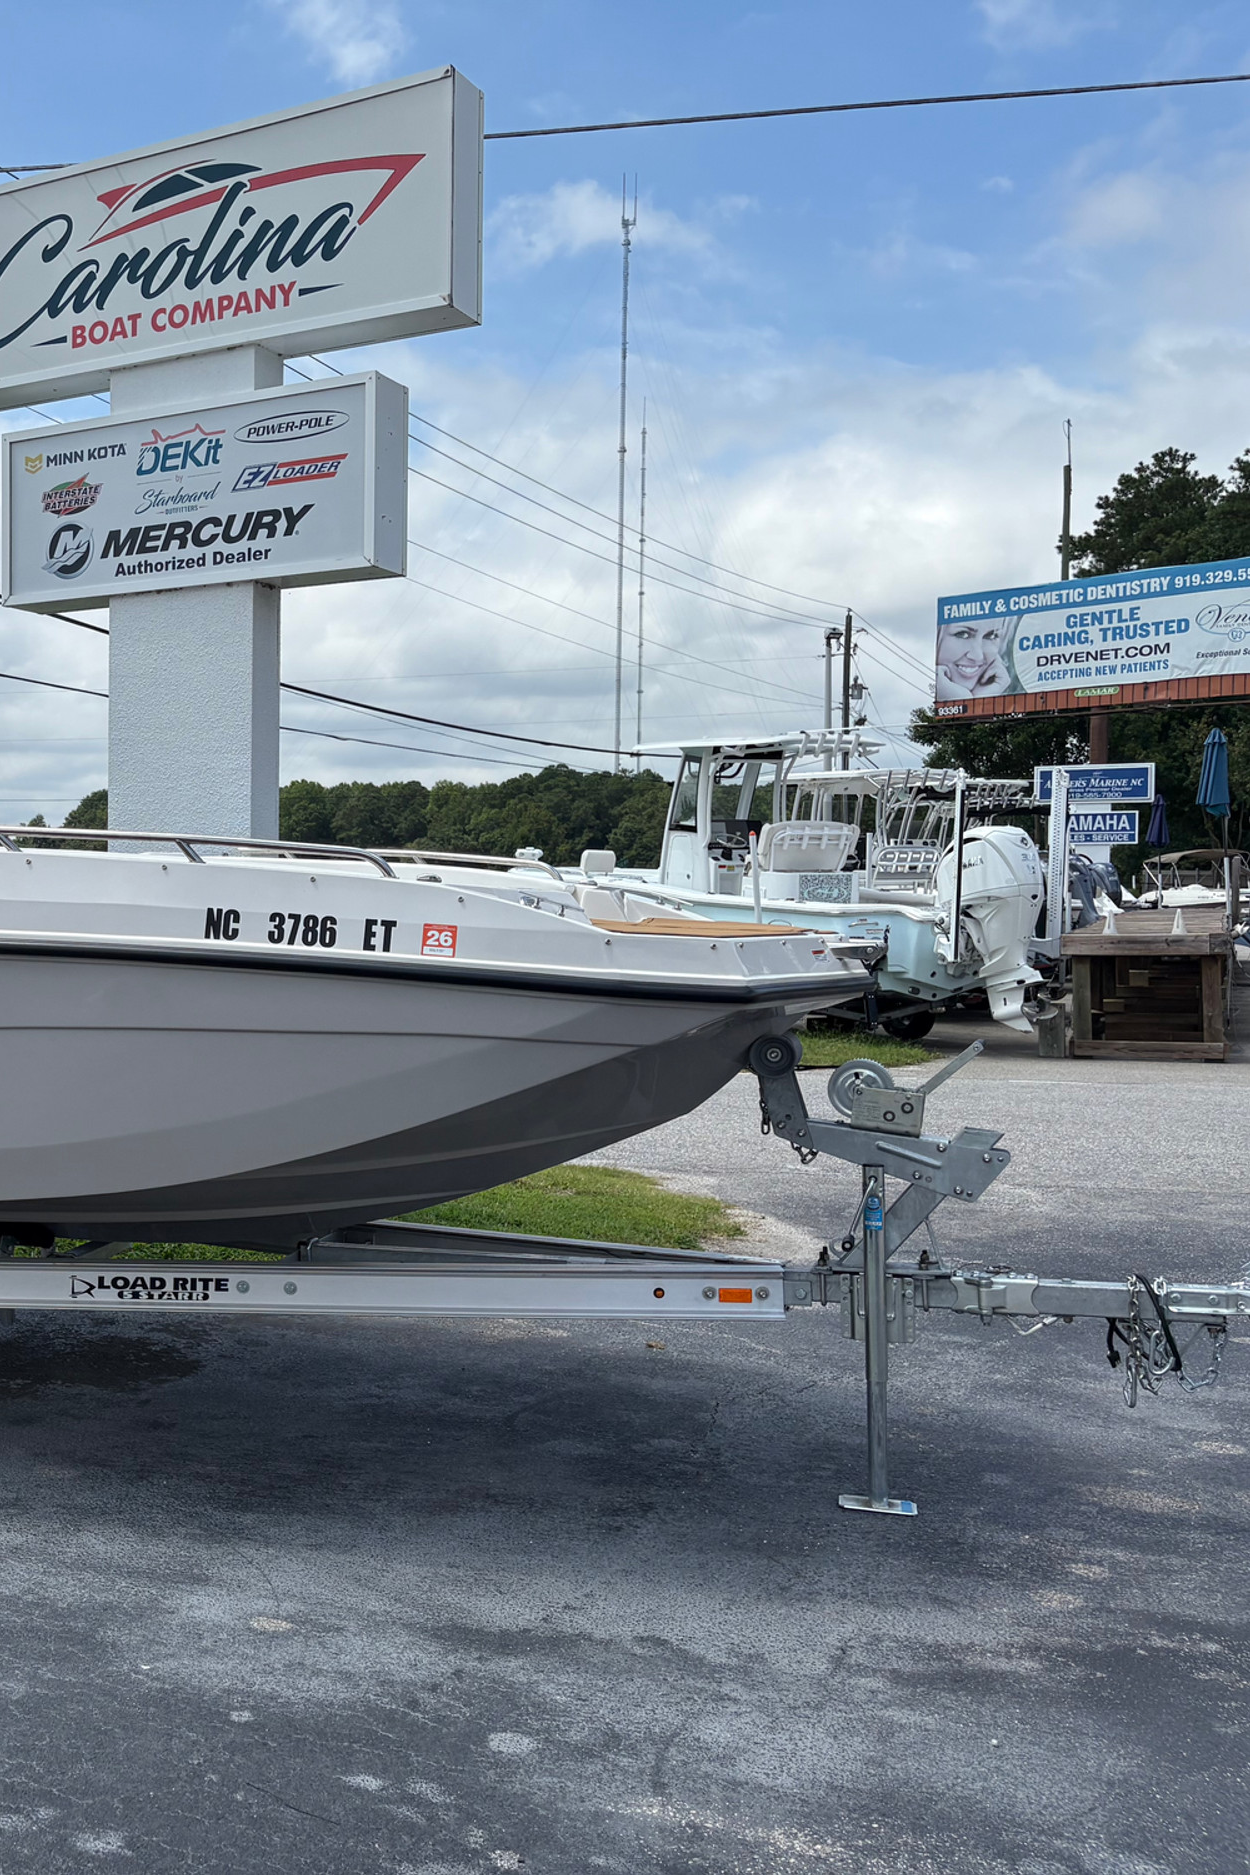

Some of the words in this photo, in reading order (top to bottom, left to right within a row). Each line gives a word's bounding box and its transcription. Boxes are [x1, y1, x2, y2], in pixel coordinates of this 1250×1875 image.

[71, 312, 142, 349] BOAT
[151, 280, 298, 333] COMPANY
[247, 414, 337, 438] POWER-POLE
[46, 449, 84, 467] MINN
[87, 443, 127, 460] KOTA
[174, 474, 184, 483] by
[233, 463, 277, 492] EZ
[272, 461, 342, 479] LOADER
[42, 484, 101, 501] INTERSTATE
[44, 496, 96, 511] BATTERIES
[134, 481, 222, 515] Starboard
[165, 504, 199, 515] OUTFITTERS
[100, 503, 316, 559] MERCURY
[114, 552, 206, 577] Authorized
[212, 547, 272, 566] Dealer
[943, 600, 992, 619] FAMILY
[994, 598, 1007, 613] &
[1010, 587, 1084, 611] COSMETIC
[1087, 576, 1171, 601] DENTISTRY
[1065, 606, 1141, 629] GENTLE
[1196, 603, 1250, 629] Ven
[1018, 629, 1094, 651] CARING,
[1098, 618, 1190, 643] TRUSTED
[1036, 642, 1170, 667] DRVENET.COM
[1196, 649, 1242, 659] Exceptional
[1037, 667, 1092, 682] ACCEPTING
[1095, 664, 1117, 677] NEW
[1120, 659, 1169, 674] PATIENTS
[938, 705, 963, 716] 93361
[1089, 778, 1128, 787] MARINE
[1130, 778, 1144, 786] NC
[1068, 814, 1130, 831] AMAHA
[1092, 832, 1129, 841] SERVICE
[204, 908, 240, 941] NC
[267, 912, 338, 948] 3786
[362, 918, 398, 952] ET
[426, 930, 453, 947] 26
[97, 1276, 167, 1290] LOAD
[173, 1277, 230, 1292] RITE
[138, 1291, 205, 1300] STARR
